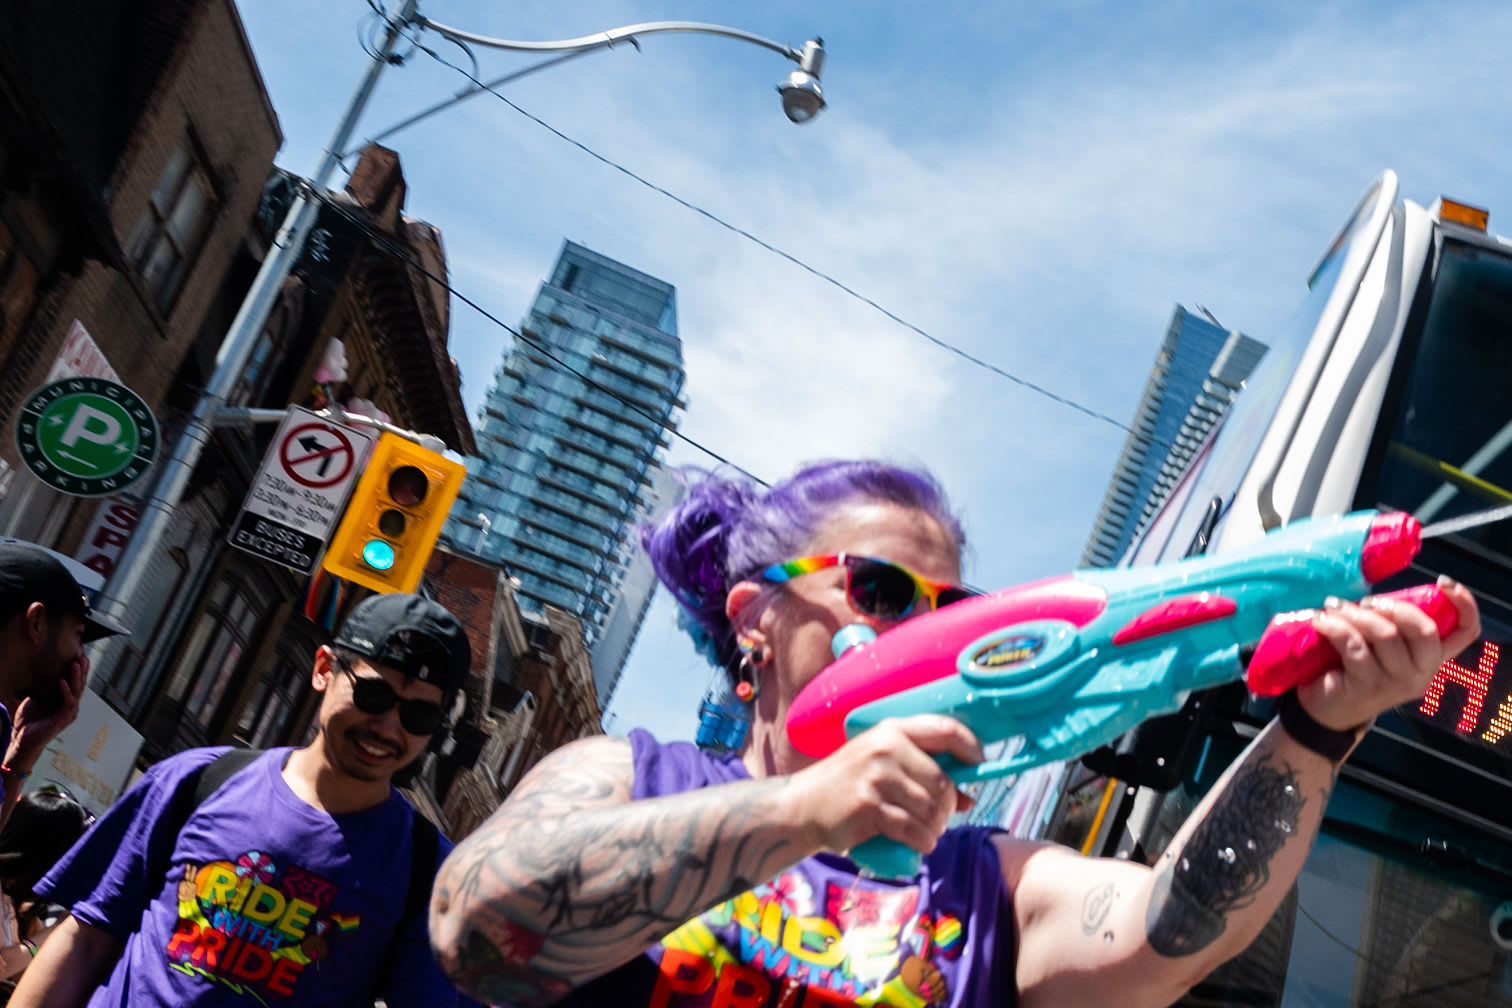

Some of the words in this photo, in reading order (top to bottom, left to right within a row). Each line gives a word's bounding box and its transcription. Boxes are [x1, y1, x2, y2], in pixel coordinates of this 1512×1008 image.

[32, 380, 154, 453] MUNICIPAL
[60, 403, 121, 449] P
[22, 424, 139, 491] PARKING
[236, 529, 312, 568] EXCEPTED
[256, 520, 306, 549] BUSES
[203, 862, 318, 942] RIDE
[213, 908, 284, 952] WITH
[168, 918, 306, 996] PRIDE
